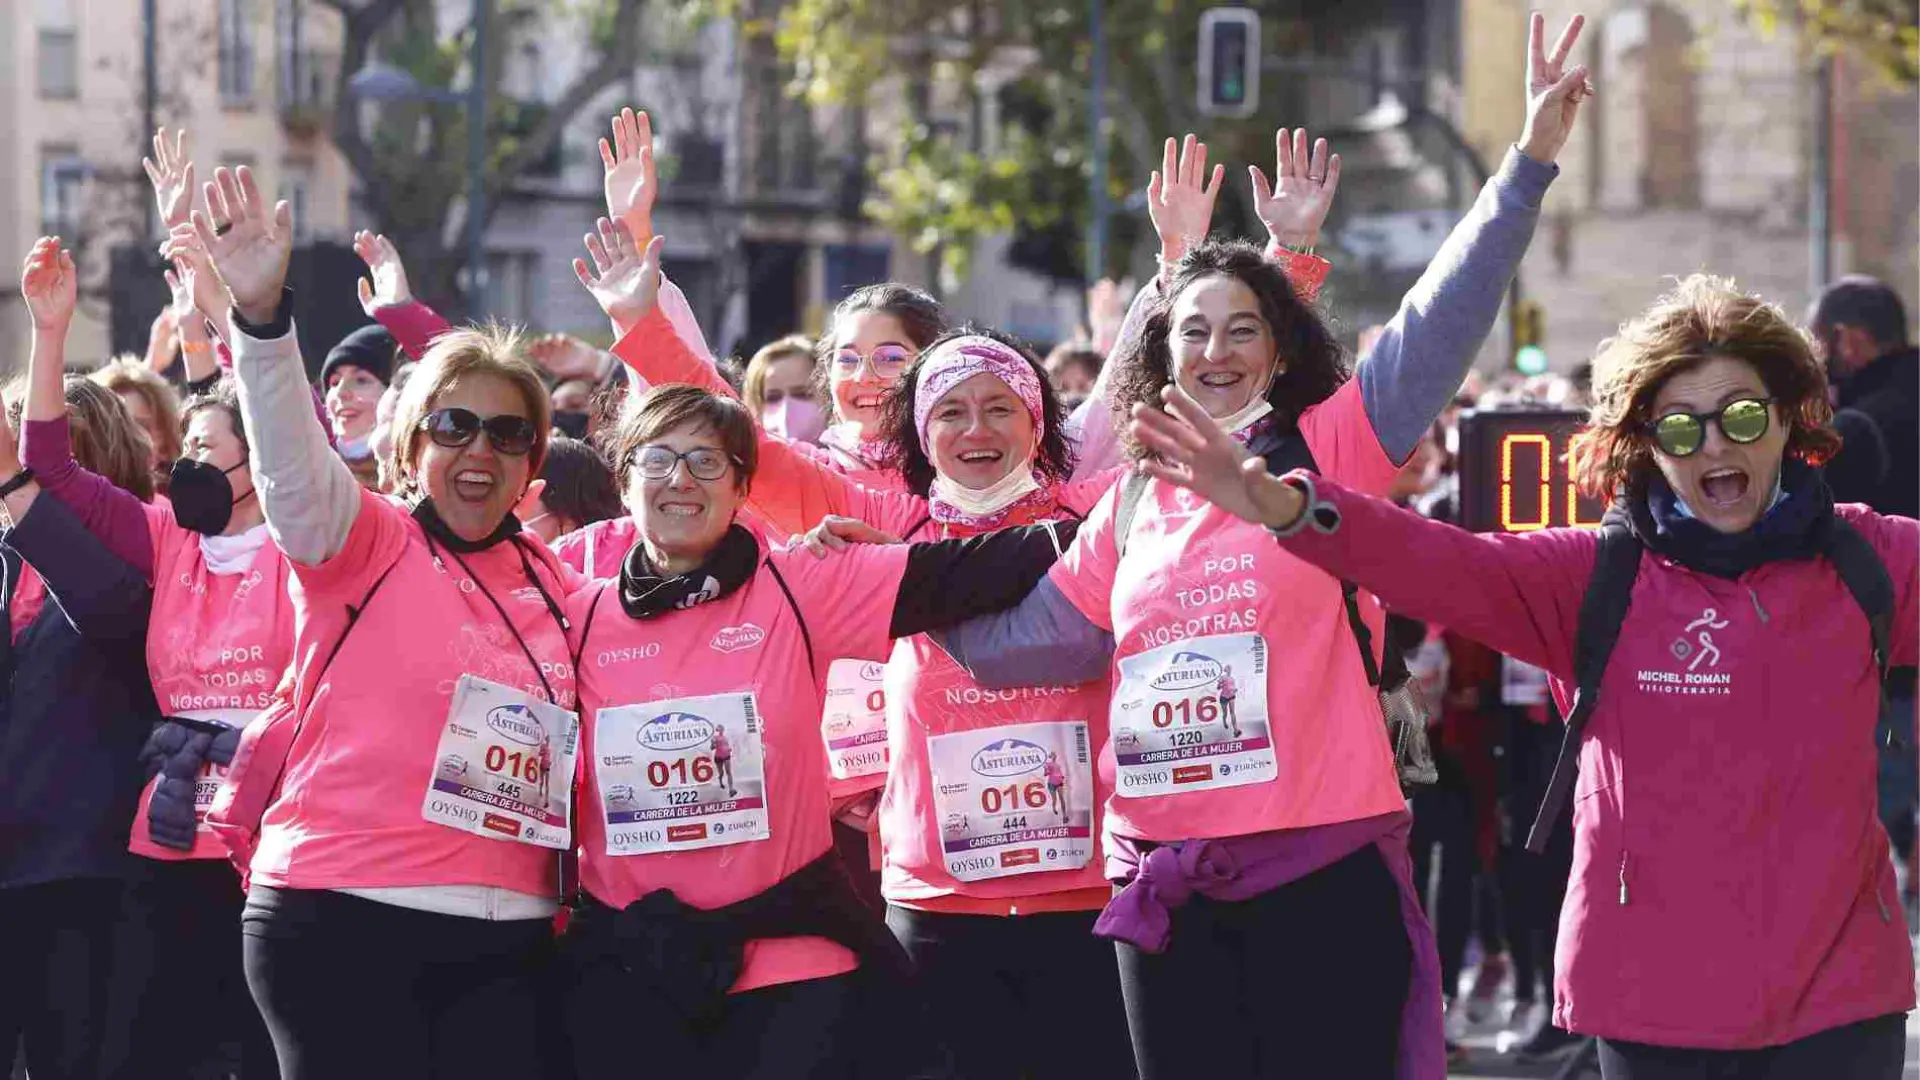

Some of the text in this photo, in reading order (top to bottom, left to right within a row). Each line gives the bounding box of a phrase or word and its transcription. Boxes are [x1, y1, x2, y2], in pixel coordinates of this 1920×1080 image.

[1204, 554, 1255, 577] POR
[1175, 579, 1257, 609] TODAS
[1140, 608, 1257, 648] NOSOTRAS
[221, 645, 264, 665] POR
[597, 642, 661, 668] OYSHO
[201, 668, 267, 688] TODAS
[1638, 670, 1731, 684] MICHEL ROMAN
[169, 691, 269, 709] NOSOTRAS
[1152, 695, 1218, 729] 016
[644, 727, 709, 744] ASTURIANA
[1169, 730, 1203, 746] 1220
[838, 752, 881, 769] OYSHO
[1140, 742, 1243, 762] CARRERA DE LA MUJER
[485, 744, 539, 784] 016
[647, 755, 714, 787] 016
[978, 754, 1042, 771] ASTURIANA
[1124, 771, 1168, 787] OYSHO
[460, 786, 498, 806] CARRERA
[499, 797, 512, 809] DE
[512, 799, 524, 812] LA
[497, 782, 521, 798] 445
[667, 790, 699, 805] 1222
[981, 782, 1048, 814] 016
[431, 800, 478, 822] OYSHO
[634, 801, 737, 821] CARRERA DE LA MUJER
[1003, 815, 1027, 830] 444
[613, 830, 661, 845] OYSHO
[969, 828, 1069, 848] CARRERA DE LA MUJER
[951, 857, 995, 873] OYSHO
